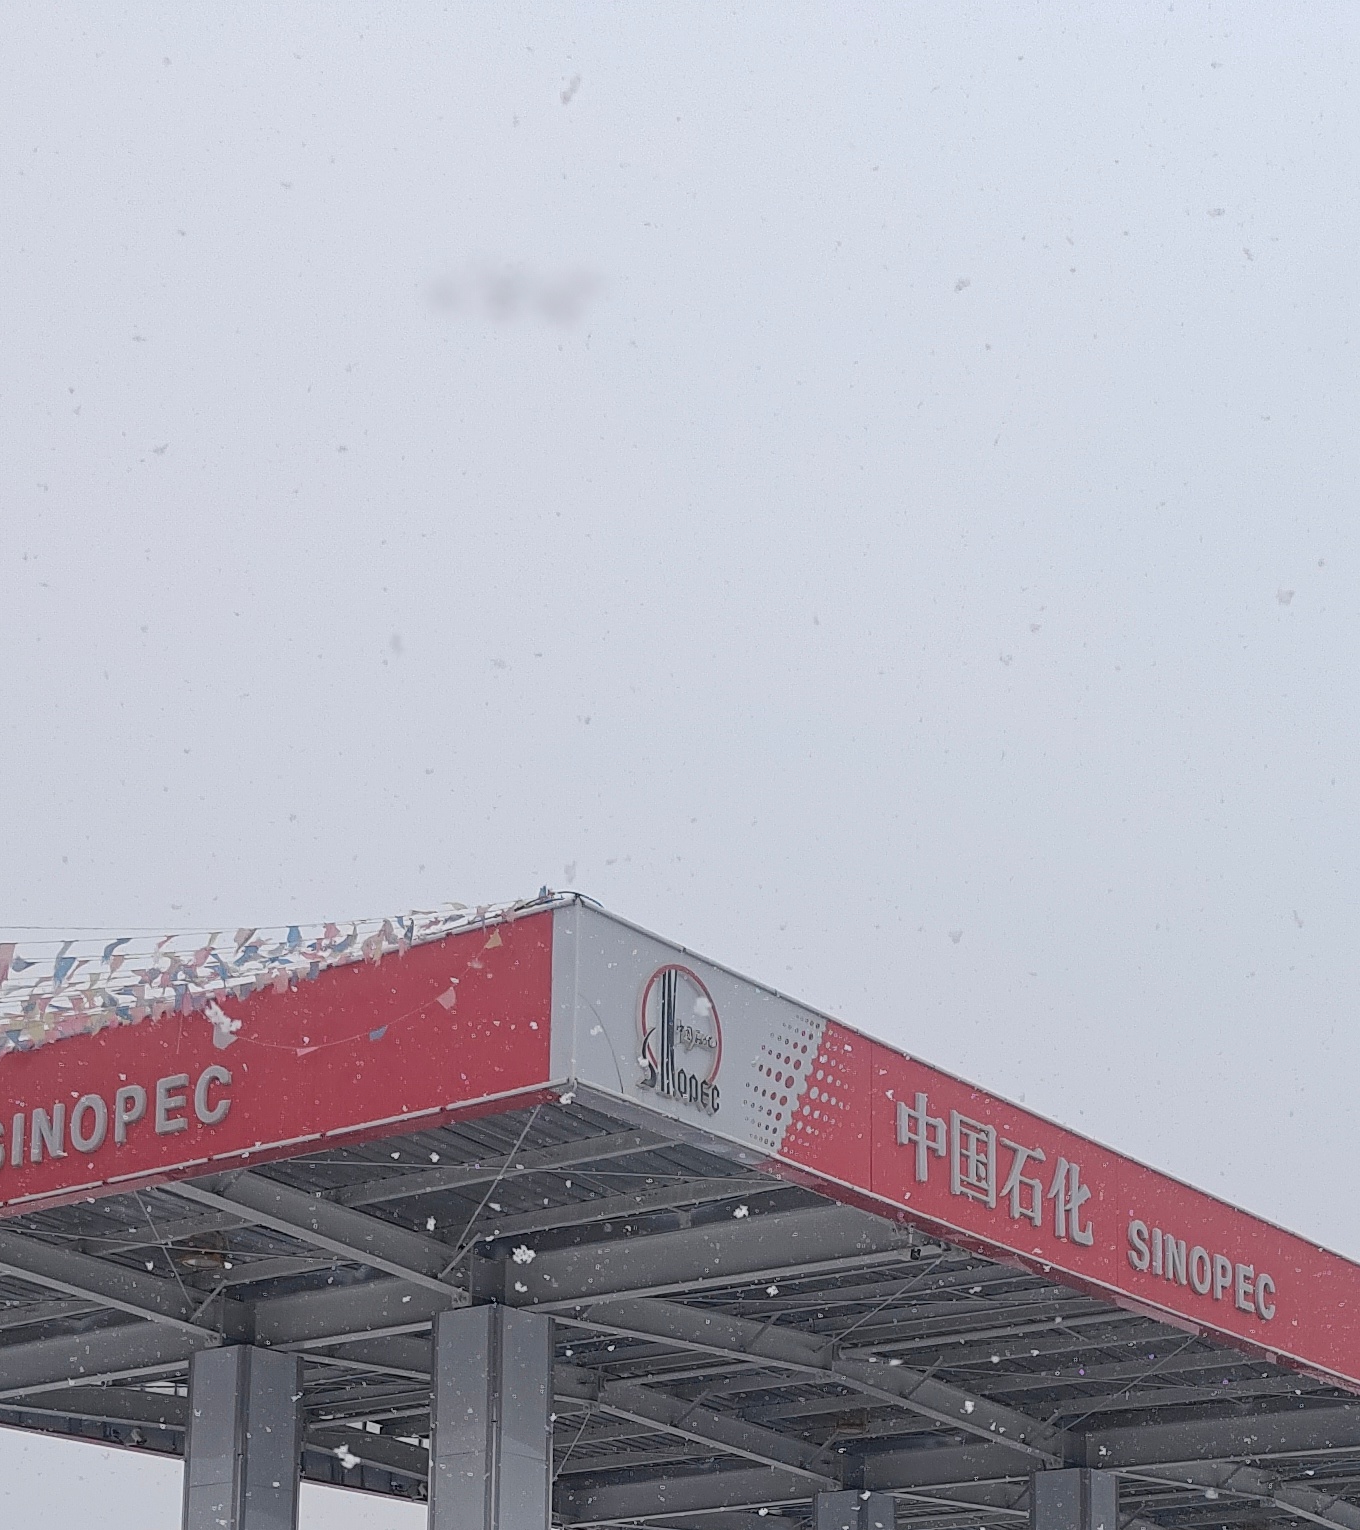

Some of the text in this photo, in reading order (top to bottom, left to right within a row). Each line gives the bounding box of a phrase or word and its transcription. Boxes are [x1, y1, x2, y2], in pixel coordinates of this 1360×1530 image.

[896, 1092, 1277, 1321] 中国石化 SINOPEC
